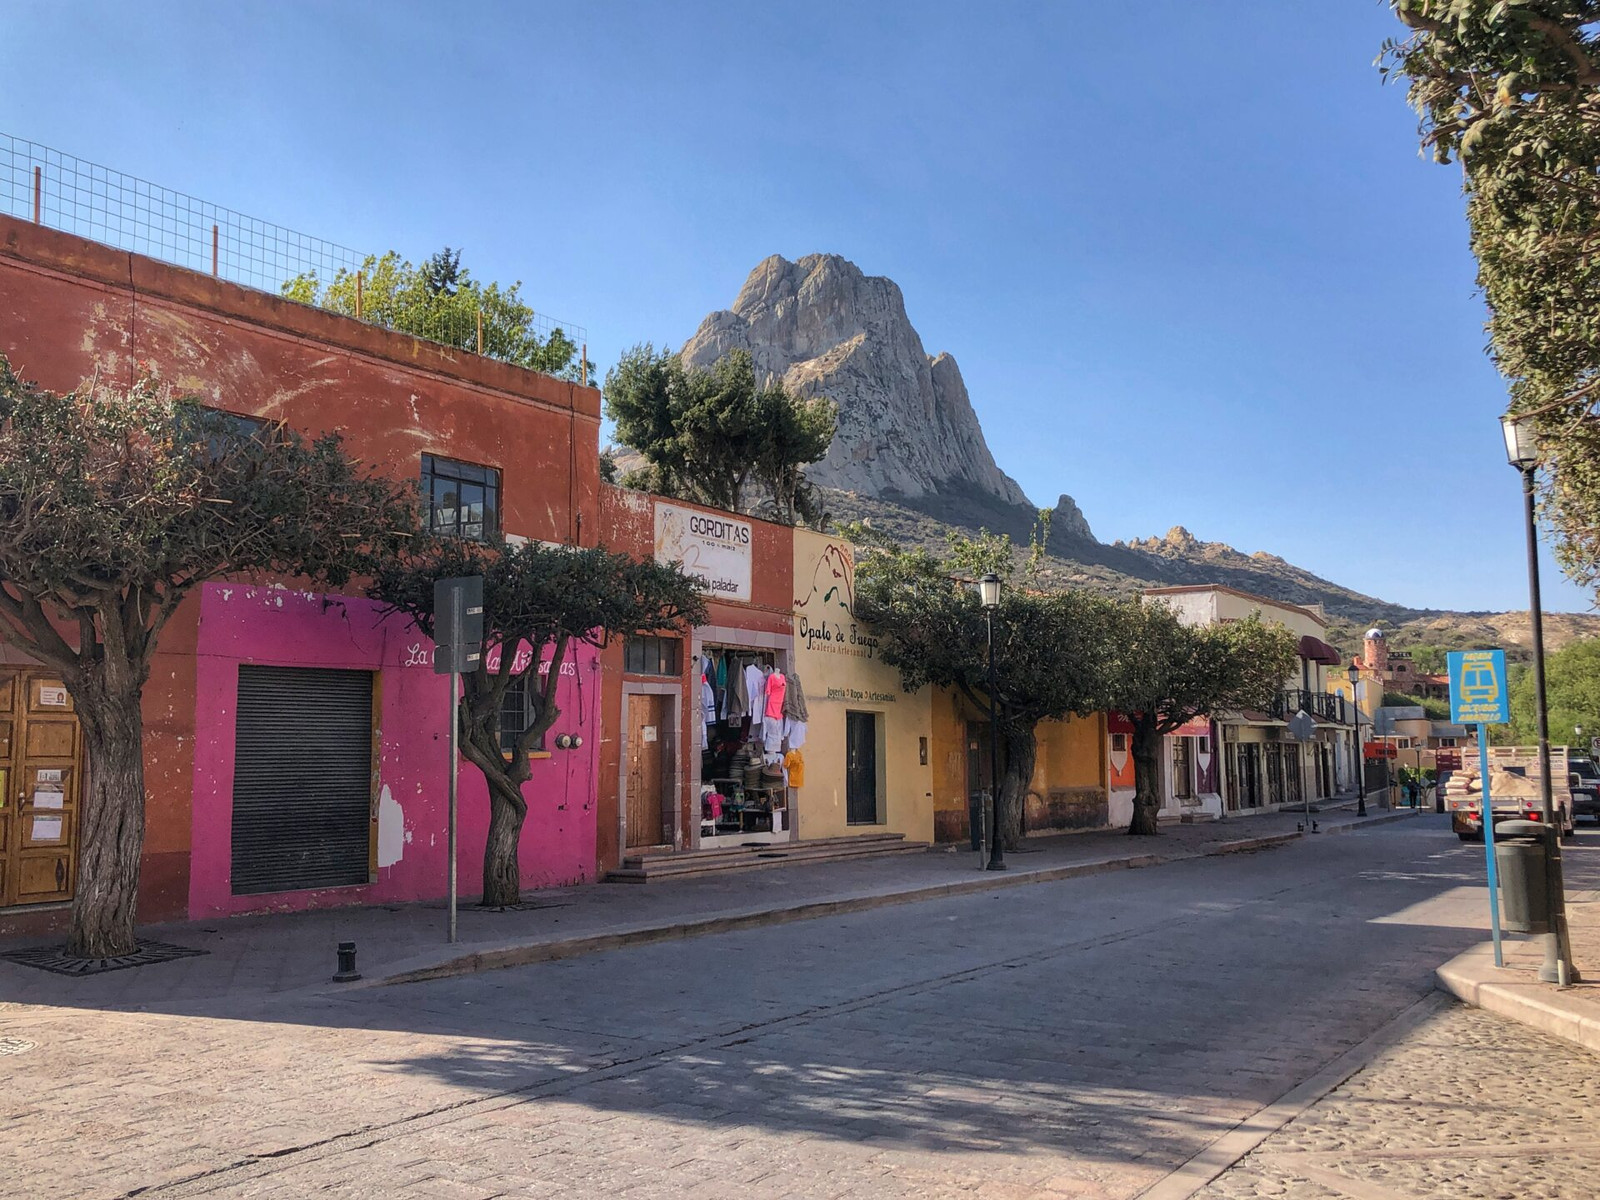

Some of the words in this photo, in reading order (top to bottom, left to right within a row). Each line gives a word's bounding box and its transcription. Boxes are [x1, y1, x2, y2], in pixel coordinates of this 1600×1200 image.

[690, 516, 749, 544] GORDITAS
[711, 577, 739, 593] paladar
[800, 616, 831, 650] Opalo
[835, 623, 845, 643] de
[849, 623, 879, 659] Fuego
[404, 642, 428, 668] La
